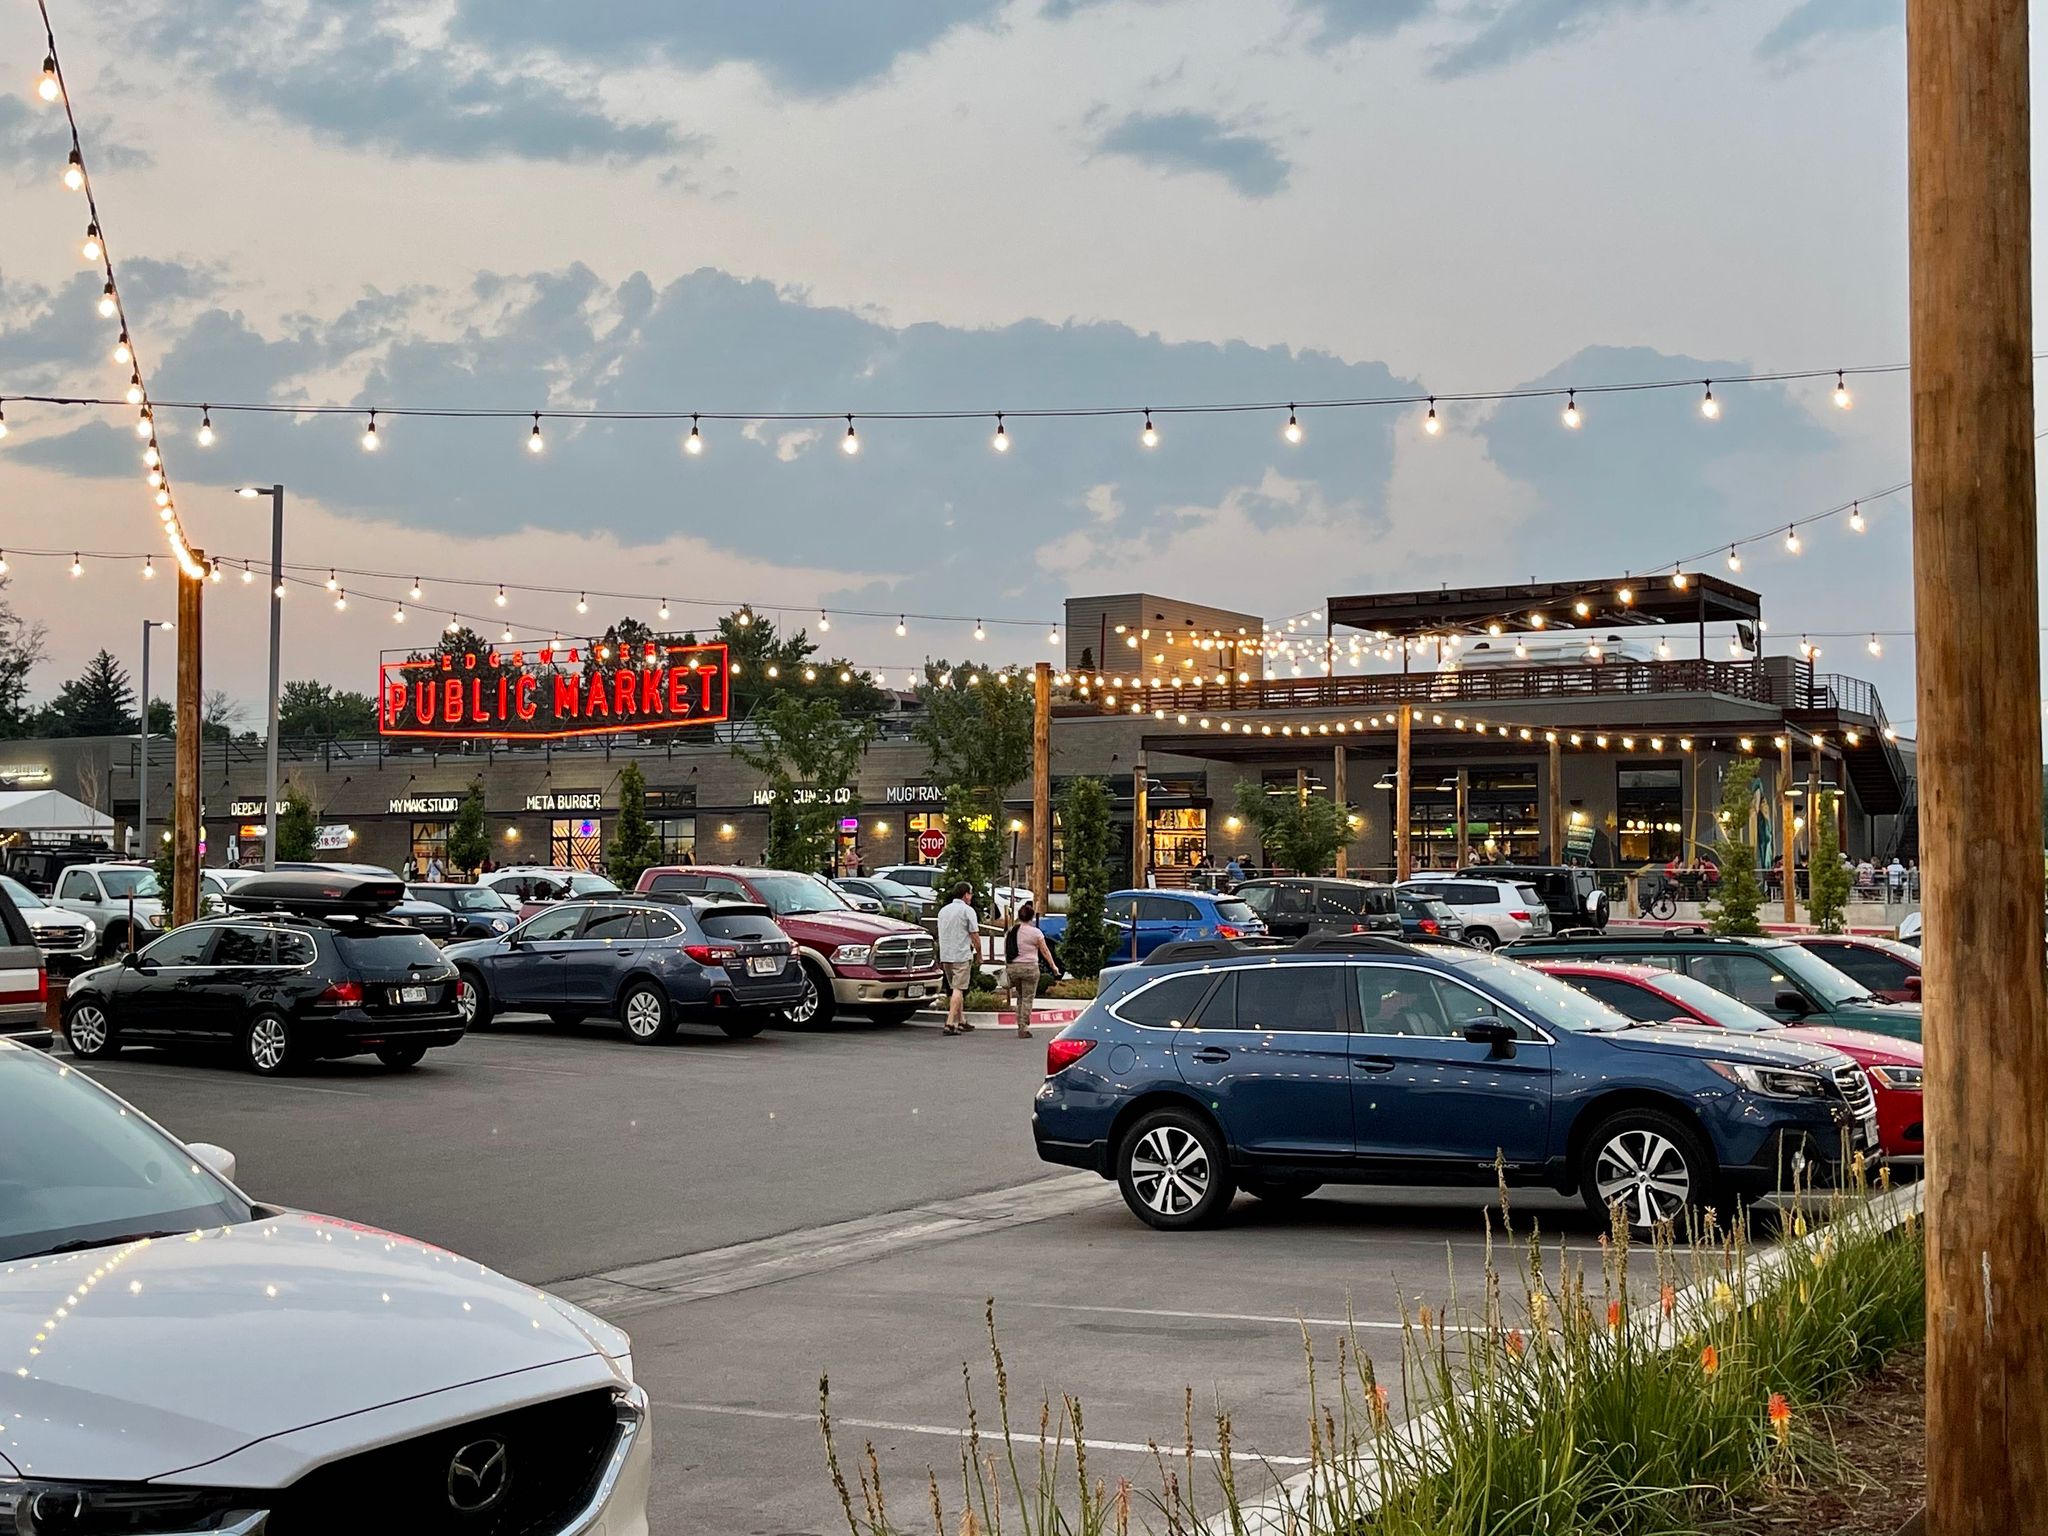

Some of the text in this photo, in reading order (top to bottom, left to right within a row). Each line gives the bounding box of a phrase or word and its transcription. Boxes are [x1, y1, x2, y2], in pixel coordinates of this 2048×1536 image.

[388, 664, 718, 727] PUBLIC MARKET
[526, 794, 601, 810] META BURGER
[753, 789, 789, 805] HAP
[834, 787, 851, 804] CO
[886, 786, 916, 802] MUGI
[920, 837, 945, 850] STOP
